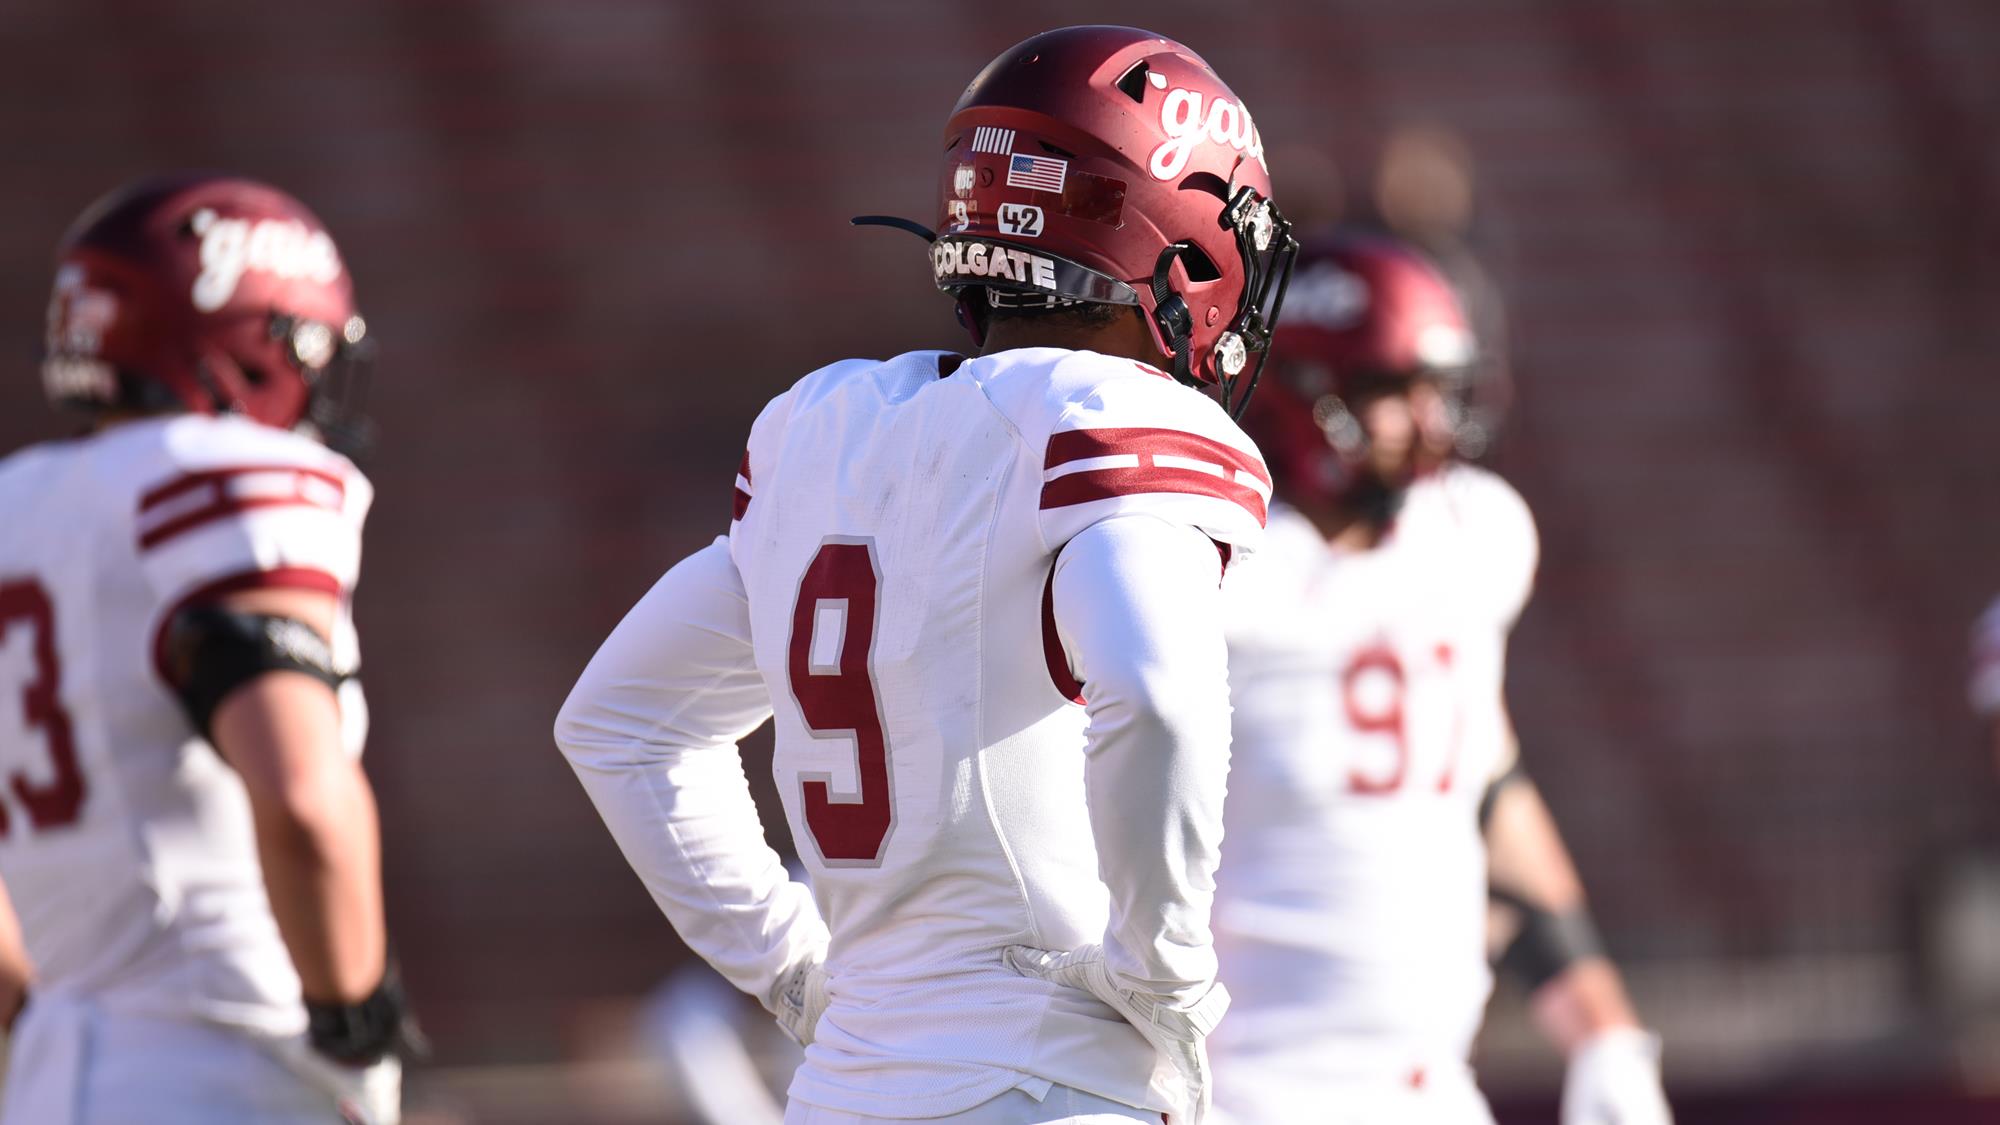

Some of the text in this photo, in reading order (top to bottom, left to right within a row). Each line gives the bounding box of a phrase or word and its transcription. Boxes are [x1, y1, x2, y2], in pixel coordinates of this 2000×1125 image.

[955, 201, 969, 231] 9
[1003, 206, 1038, 235] 42
[934, 241, 1057, 290] COLGATE
[0, 574, 88, 838] 3
[785, 534, 898, 868] 9
